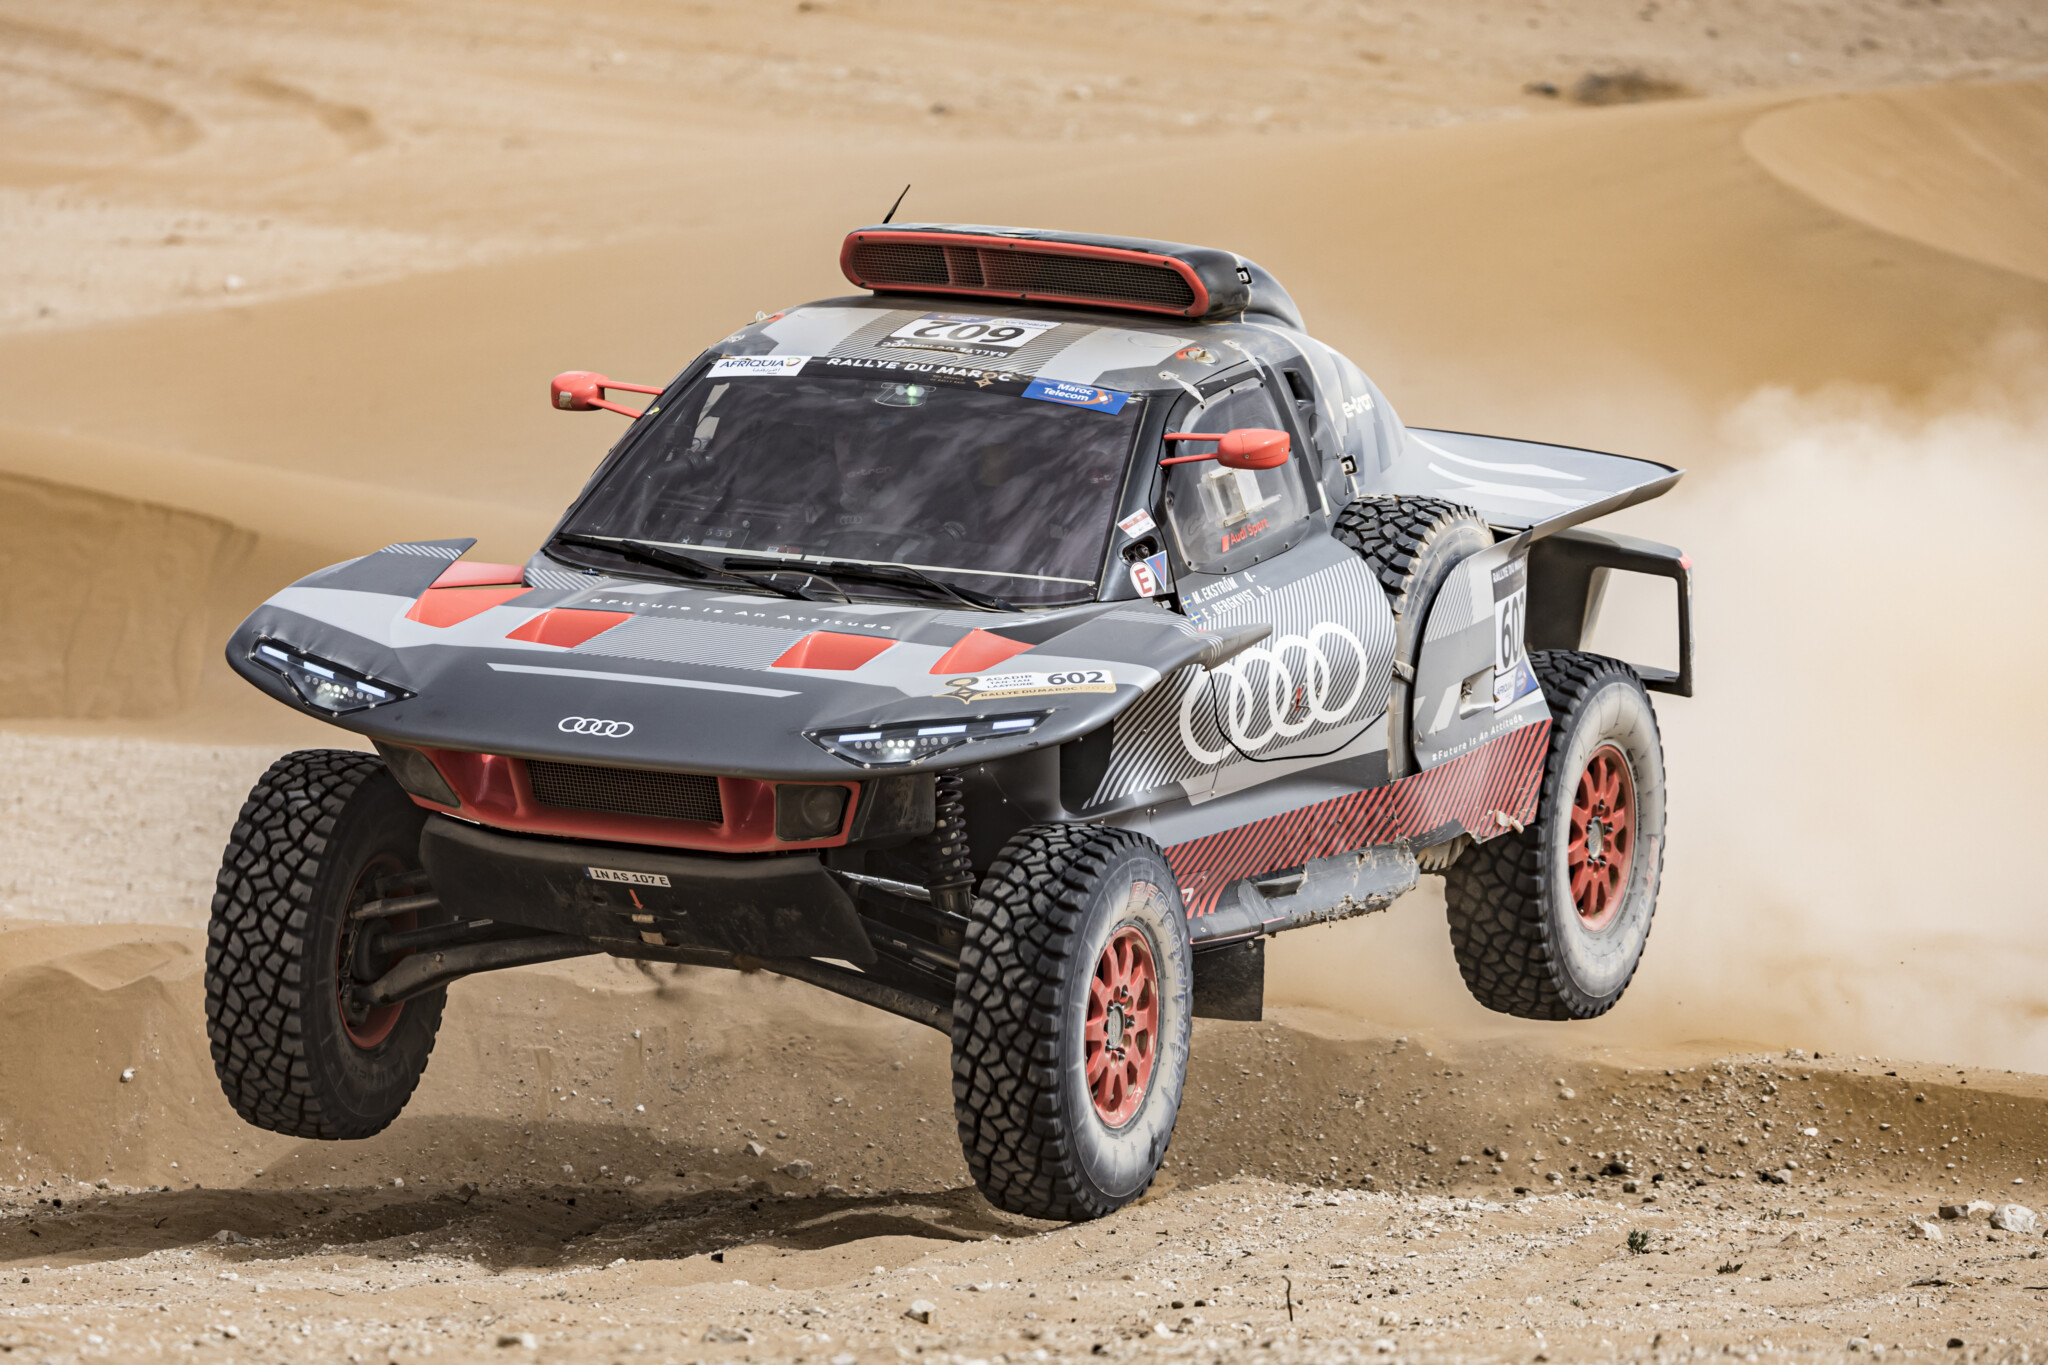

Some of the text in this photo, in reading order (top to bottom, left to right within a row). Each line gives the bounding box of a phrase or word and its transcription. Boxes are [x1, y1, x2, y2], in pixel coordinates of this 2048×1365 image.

[913, 320, 1025, 343] 602
[720, 359, 784, 369] AFRIQUIA
[826, 358, 1012, 383] RALLYE DU MAROC
[1044, 387, 1090, 402] Telecom
[1057, 383, 1094, 396] Maroc
[1342, 393, 1375, 418] e-tron
[1230, 517, 1269, 545] Audi Sport
[1134, 567, 1153, 595] E
[590, 598, 692, 611] #Future
[734, 610, 766, 618] An
[776, 614, 892, 630] Attitude
[986, 674, 1032, 682] AGADIR
[1047, 671, 1106, 685] 602
[981, 690, 1018, 698] RALLYE
[1431, 741, 1467, 761] #Future
[1479, 731, 1489, 741] An
[1490, 714, 1524, 735] Attitude
[594, 869, 669, 886] IN AS 107 E
